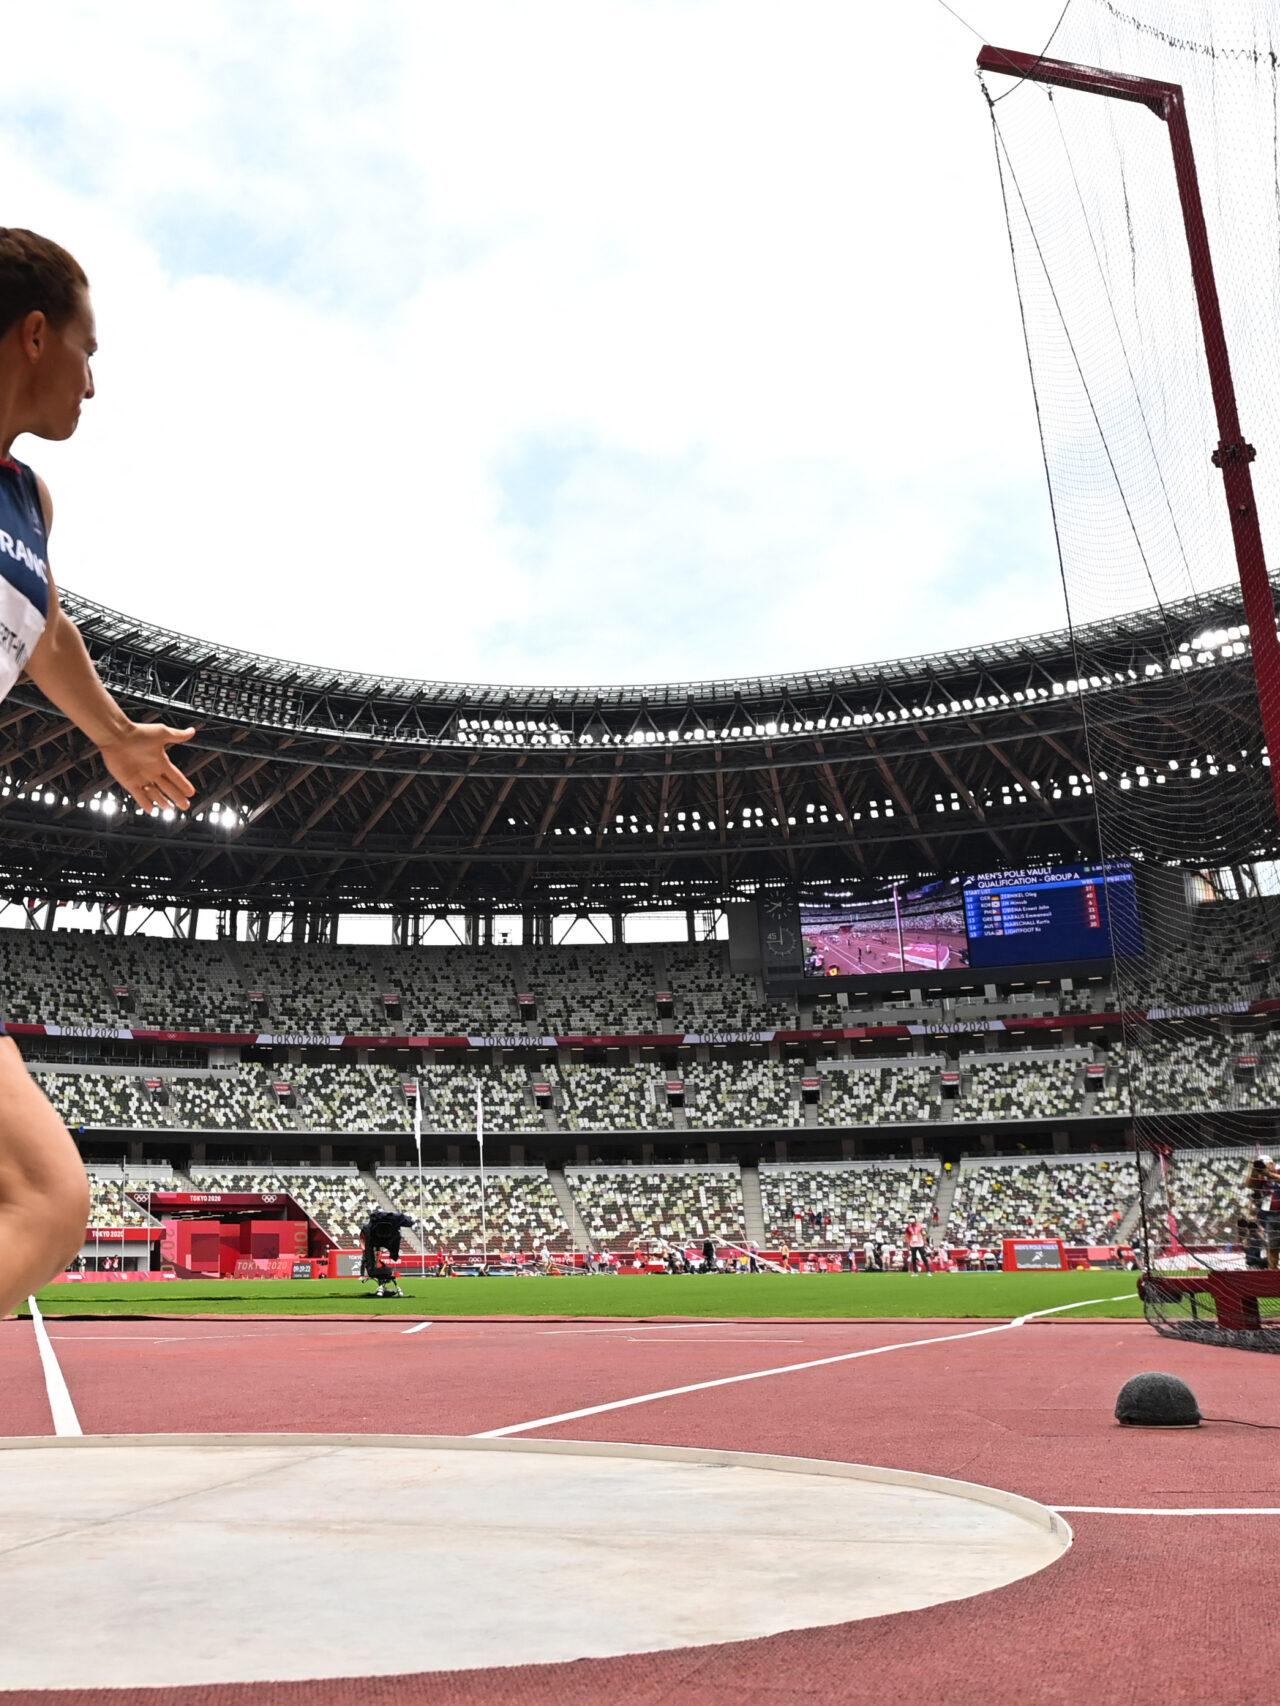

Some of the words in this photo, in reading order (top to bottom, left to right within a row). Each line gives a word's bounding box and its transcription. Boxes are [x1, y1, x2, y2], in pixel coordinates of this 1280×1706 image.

[977, 872, 1003, 881] MEN'S
[1004, 870, 1025, 879] POLE
[1026, 867, 1052, 876] VAULT
[977, 876, 1037, 888] QUALIFICATION
[1044, 873, 1069, 883] GROUP
[1071, 872, 1080, 880] A
[59, 1025, 93, 1037] TOKYO
[95, 1027, 119, 1038] 2020
[923, 1023, 960, 1034] TOKYO
[962, 1021, 990, 1032] 2020
[271, 1034, 303, 1045] TOKYO
[306, 1035, 331, 1046] 2020
[481, 1036, 516, 1047] TOKYO
[519, 1036, 544, 1047] 2020
[697, 1033, 732, 1043] TOKYO
[735, 1032, 760, 1042] 2020
[92, 1230, 110, 1238] TOKYO
